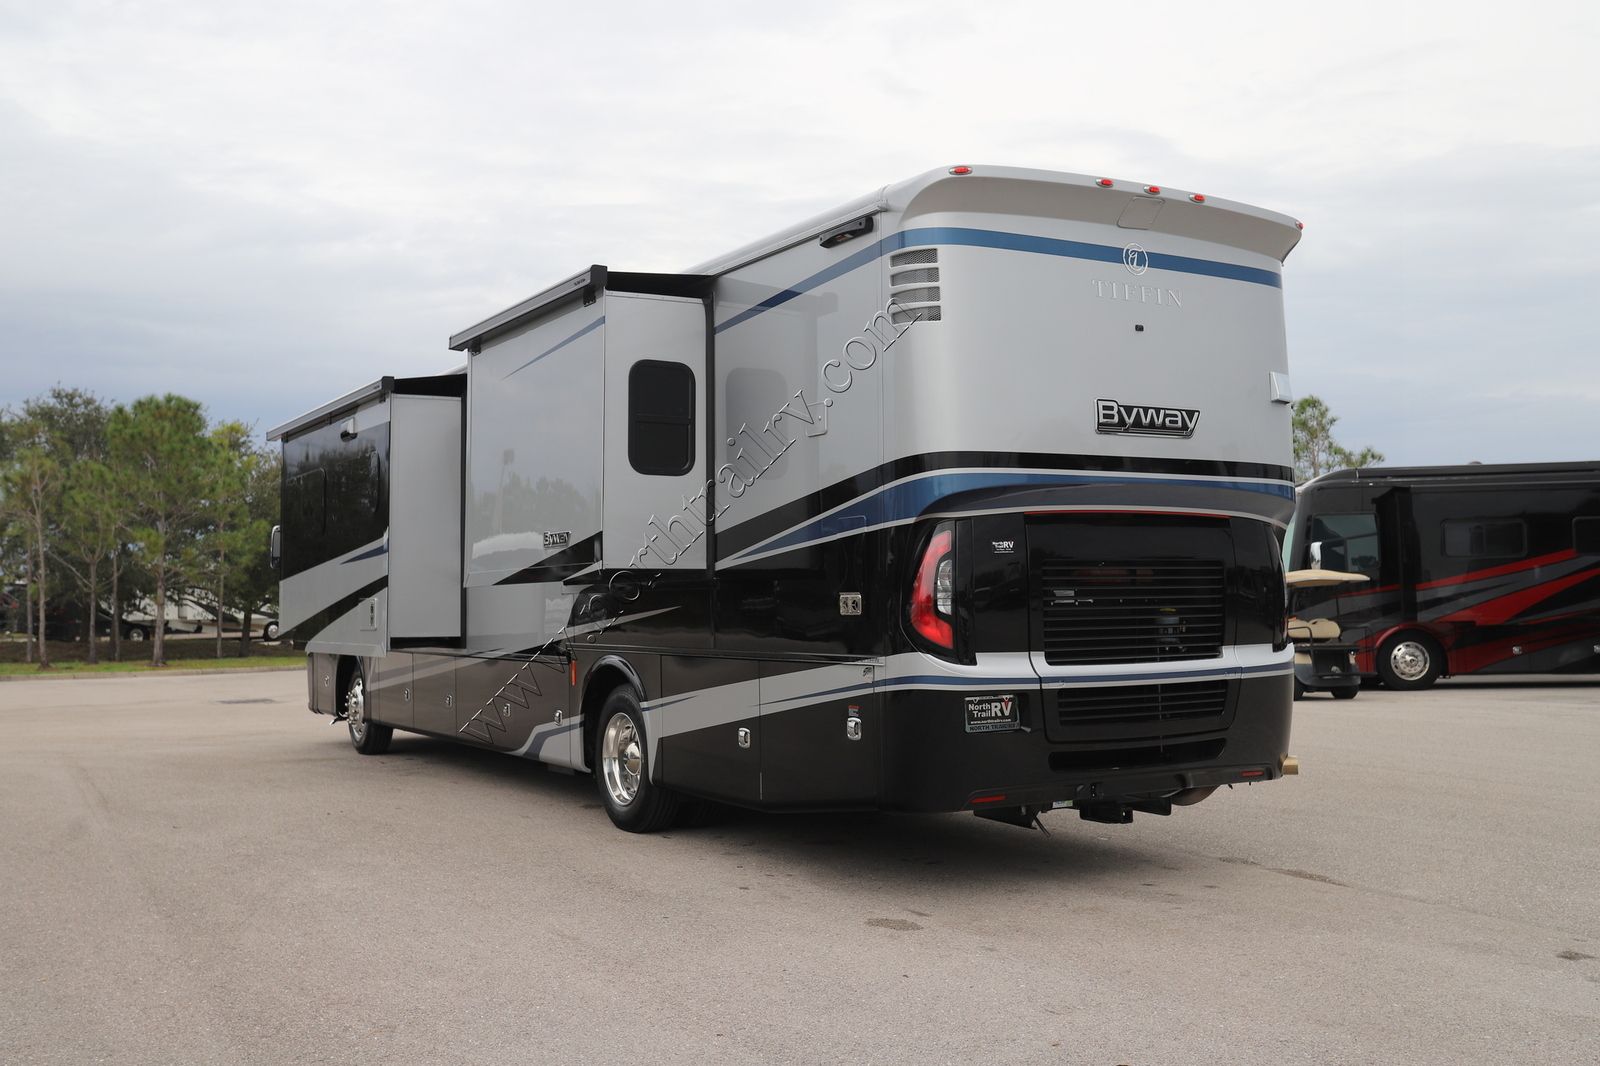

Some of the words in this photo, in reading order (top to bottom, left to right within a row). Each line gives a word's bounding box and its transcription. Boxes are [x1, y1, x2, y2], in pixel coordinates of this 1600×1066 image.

[1092, 279, 1183, 310] TIFFIN
[1098, 400, 1199, 434] Byway
[1003, 541, 1014, 549] RV
[968, 703, 990, 711] North
[991, 701, 1012, 717] RV
[972, 710, 990, 718] Trail
